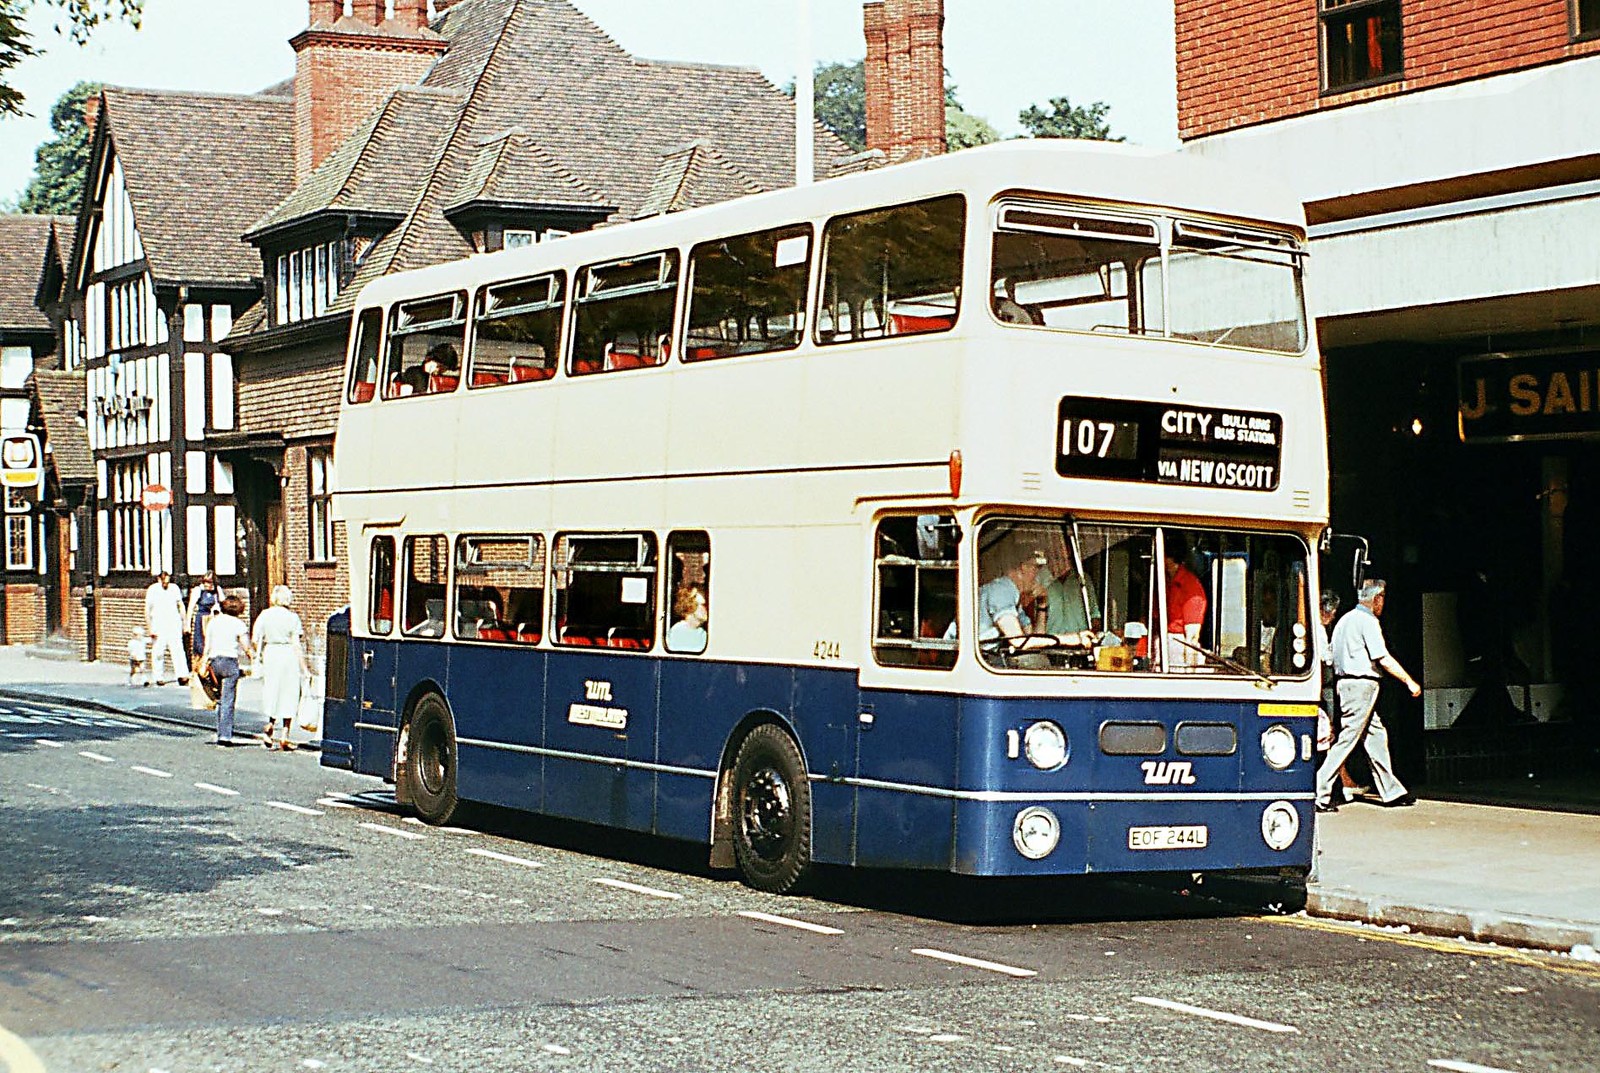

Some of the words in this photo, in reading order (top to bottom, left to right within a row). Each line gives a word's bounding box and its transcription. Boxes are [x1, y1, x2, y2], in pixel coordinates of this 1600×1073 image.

[1461, 379, 1486, 420] J
[1509, 369, 1600, 416] SAI
[1161, 410, 1212, 436] CITY
[1222, 414, 1248, 429] BULL
[1249, 417, 1271, 431] RING
[1062, 419, 1115, 458] 107
[1214, 426, 1235, 441] BUS
[1237, 429, 1276, 445] STATION
[1158, 461, 1178, 477] VIA
[813, 640, 840, 660] 4244
[1132, 830, 1162, 846] EOF
[1166, 829, 1204, 845] 244L
